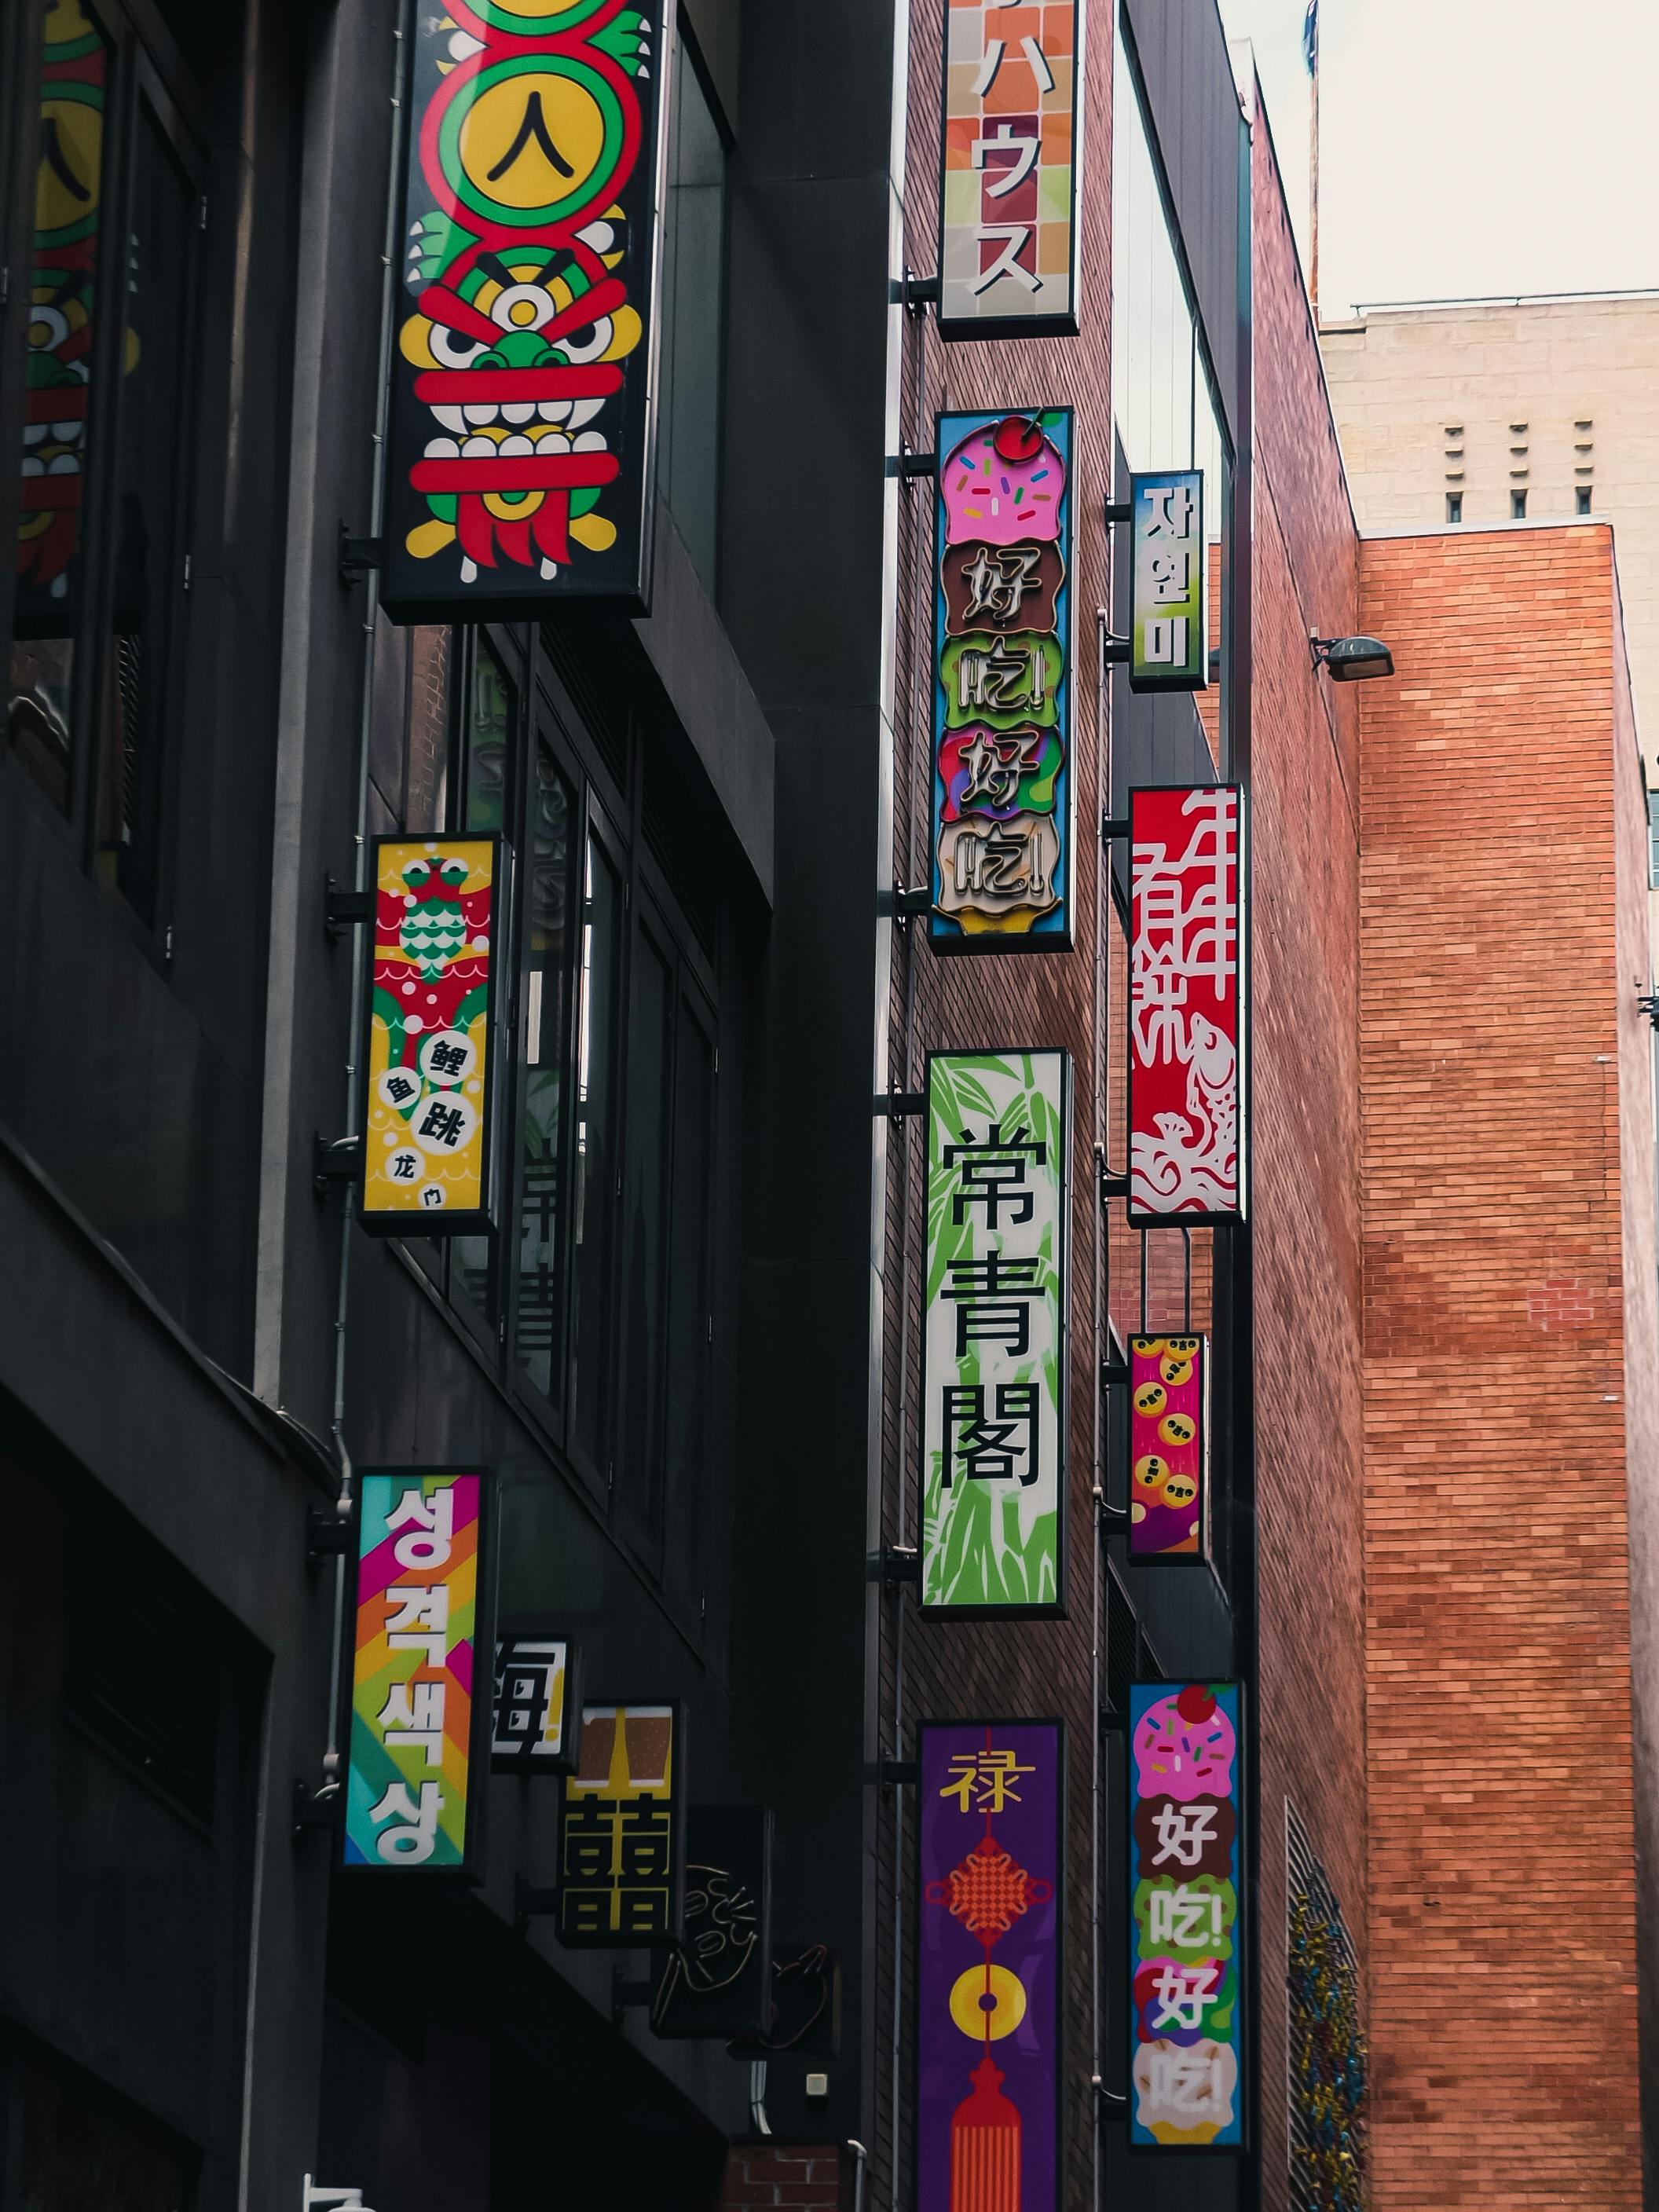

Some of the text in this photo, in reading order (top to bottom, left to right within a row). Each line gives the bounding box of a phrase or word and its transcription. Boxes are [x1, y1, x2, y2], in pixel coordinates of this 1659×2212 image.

[487, 90, 575, 182] 人
[969, 0, 1056, 296] ハウス
[1144, 487, 1193, 668] 자연미
[940, 1123, 1046, 1489] 常青閣
[368, 1487, 454, 1865] 성격색상
